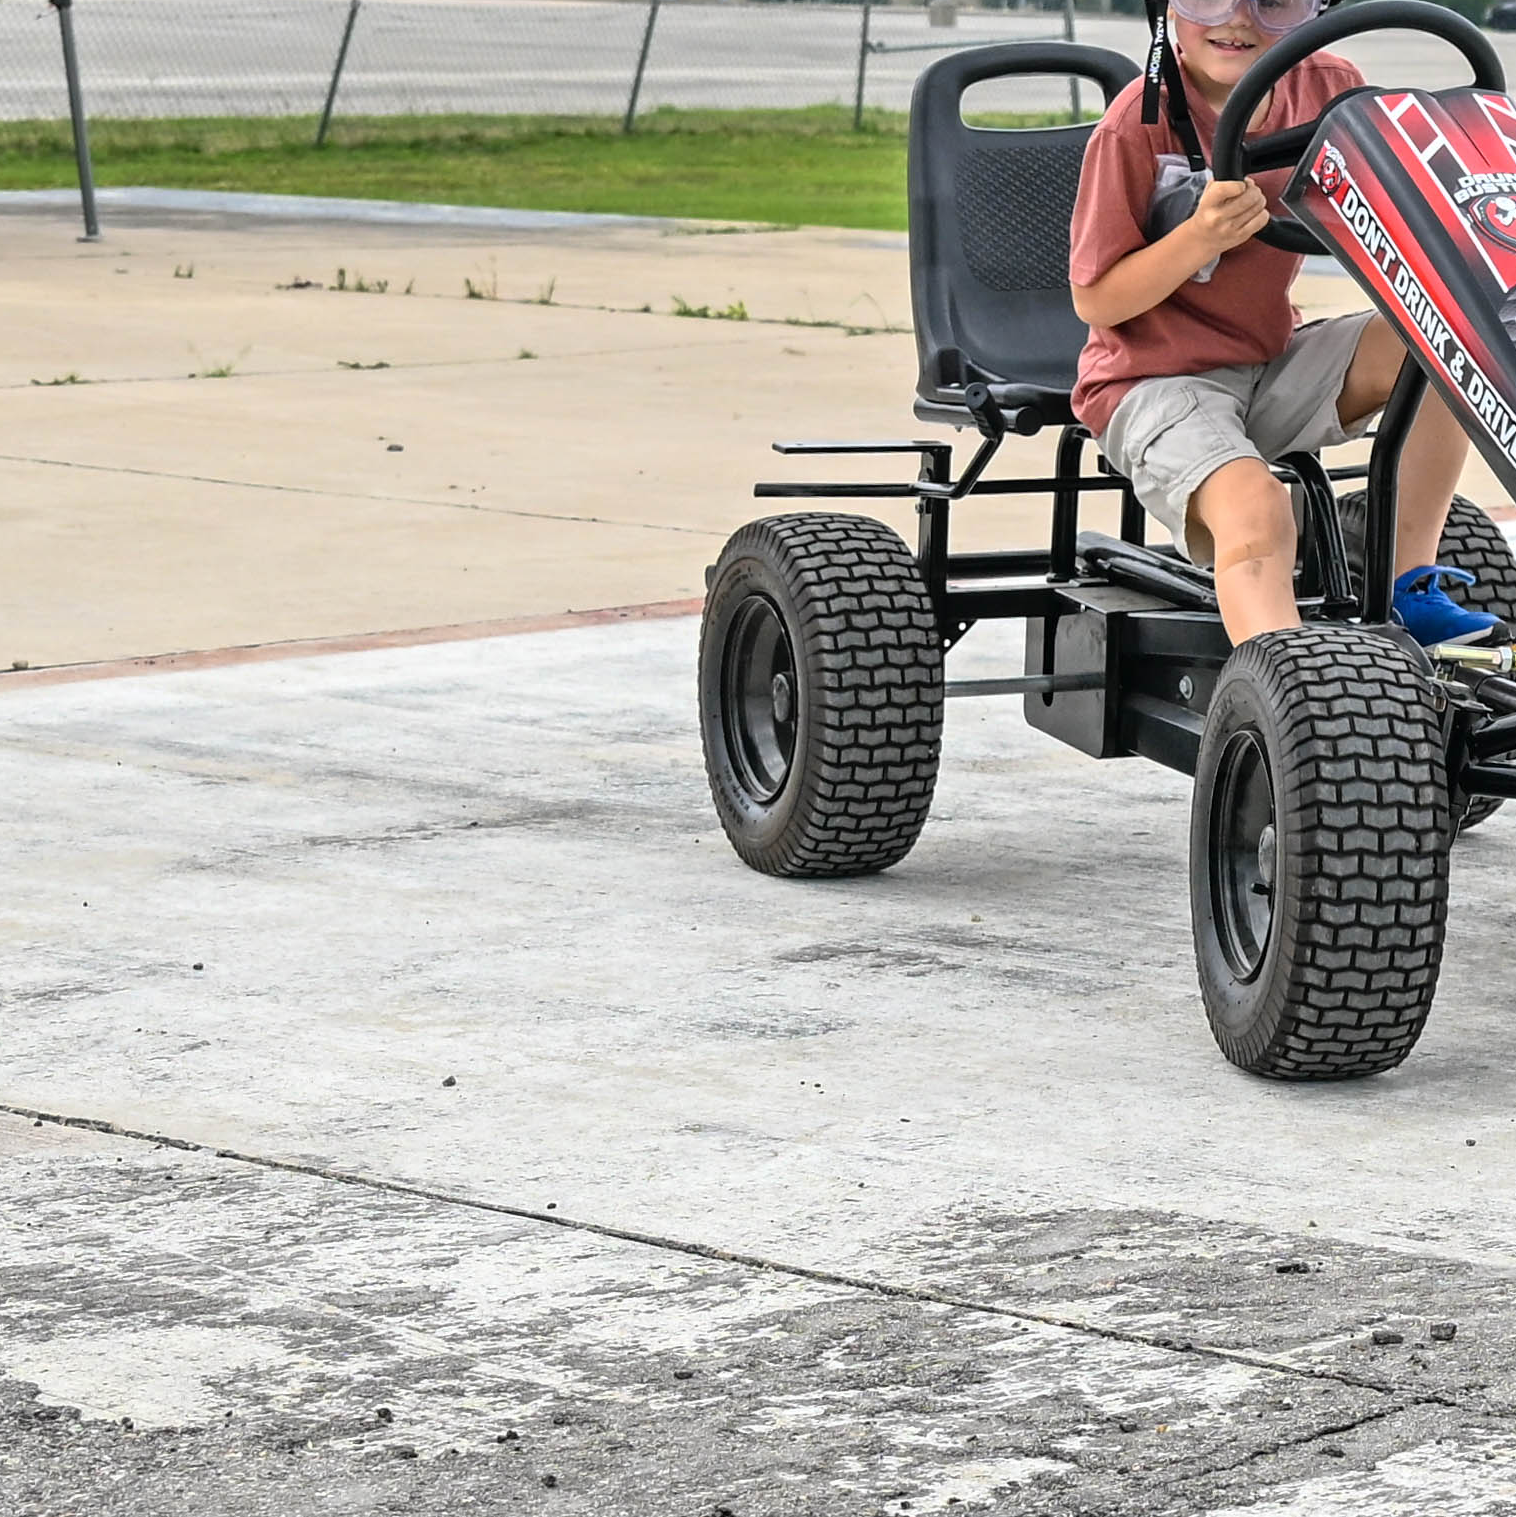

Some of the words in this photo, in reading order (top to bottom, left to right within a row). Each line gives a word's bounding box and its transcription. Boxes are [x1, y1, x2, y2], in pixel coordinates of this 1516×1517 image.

[1154, 16, 1164, 45] FATAL
[1341, 187, 1396, 273] DON'T
[1394, 267, 1452, 359] DRINK
[1450, 350, 1465, 383] &
